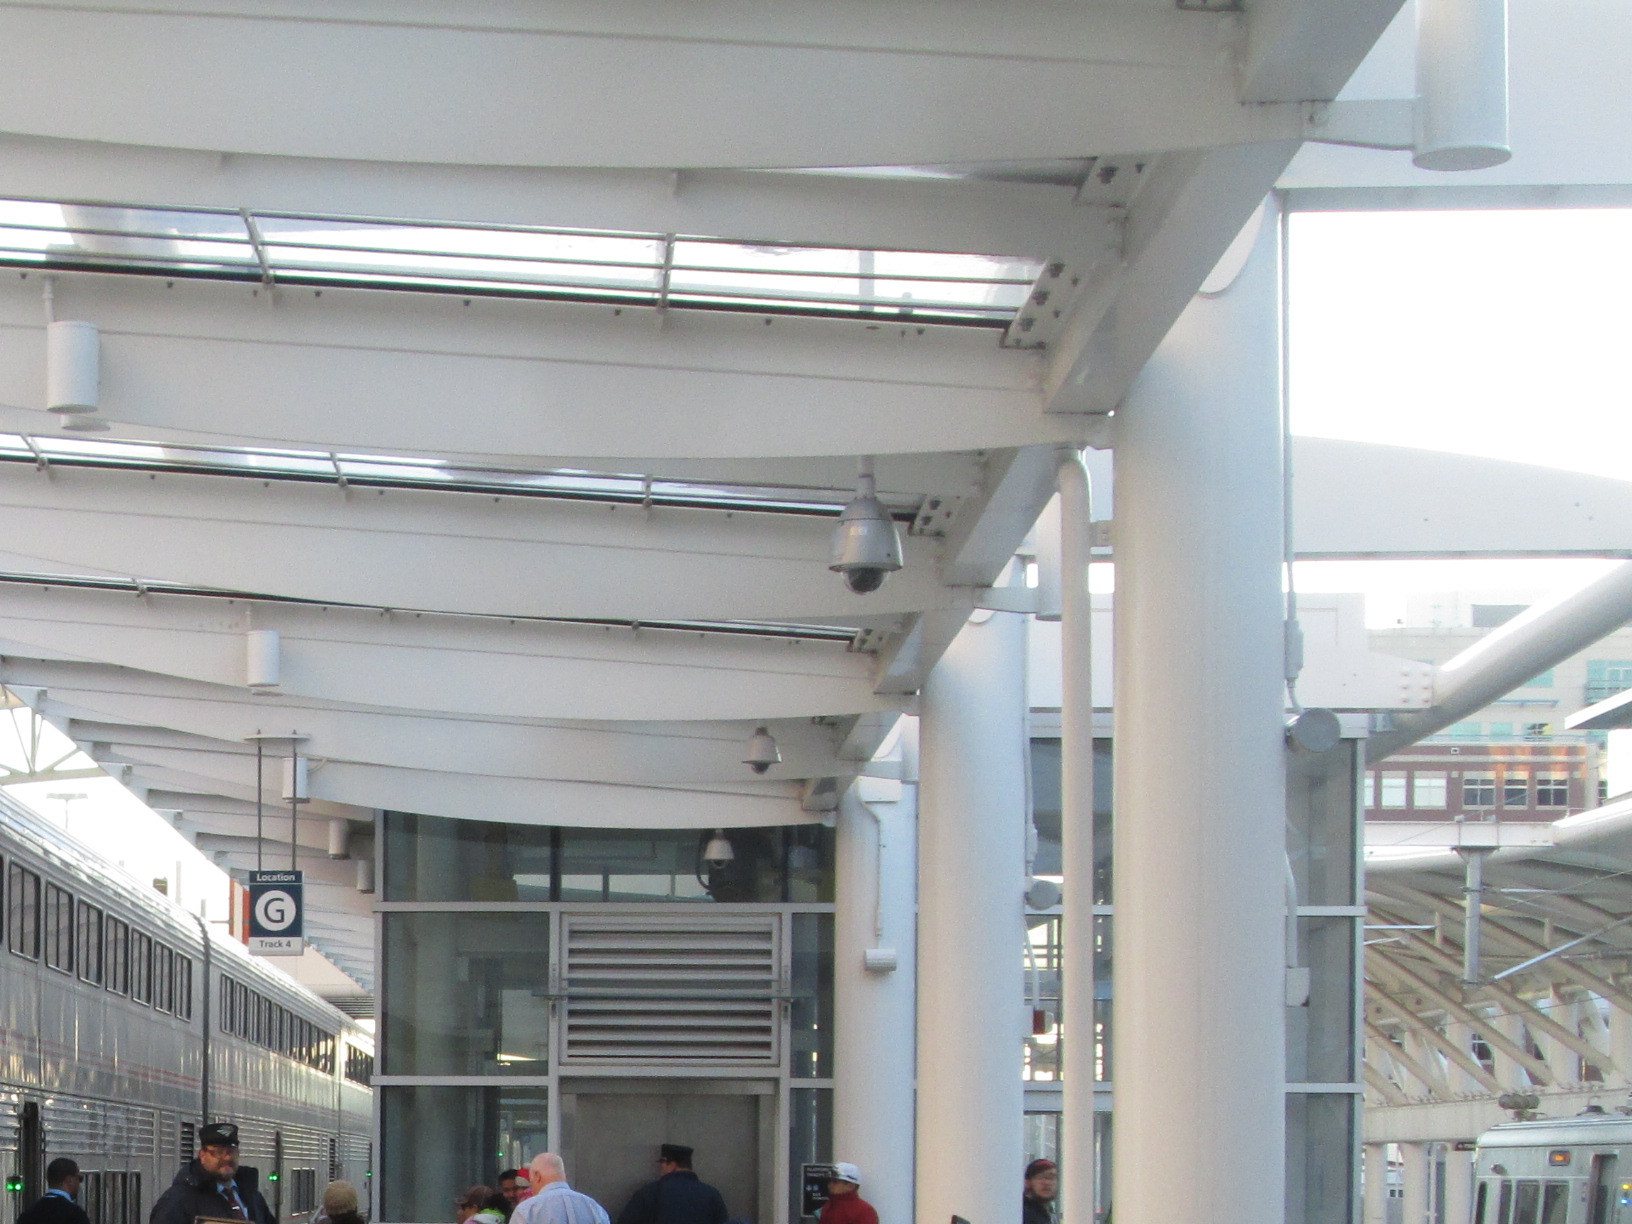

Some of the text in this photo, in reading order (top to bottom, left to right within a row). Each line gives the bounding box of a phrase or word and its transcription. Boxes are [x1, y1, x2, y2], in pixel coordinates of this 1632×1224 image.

[256, 873, 296, 882] Location
[263, 897, 285, 924] G
[259, 940, 292, 948] Track 4
